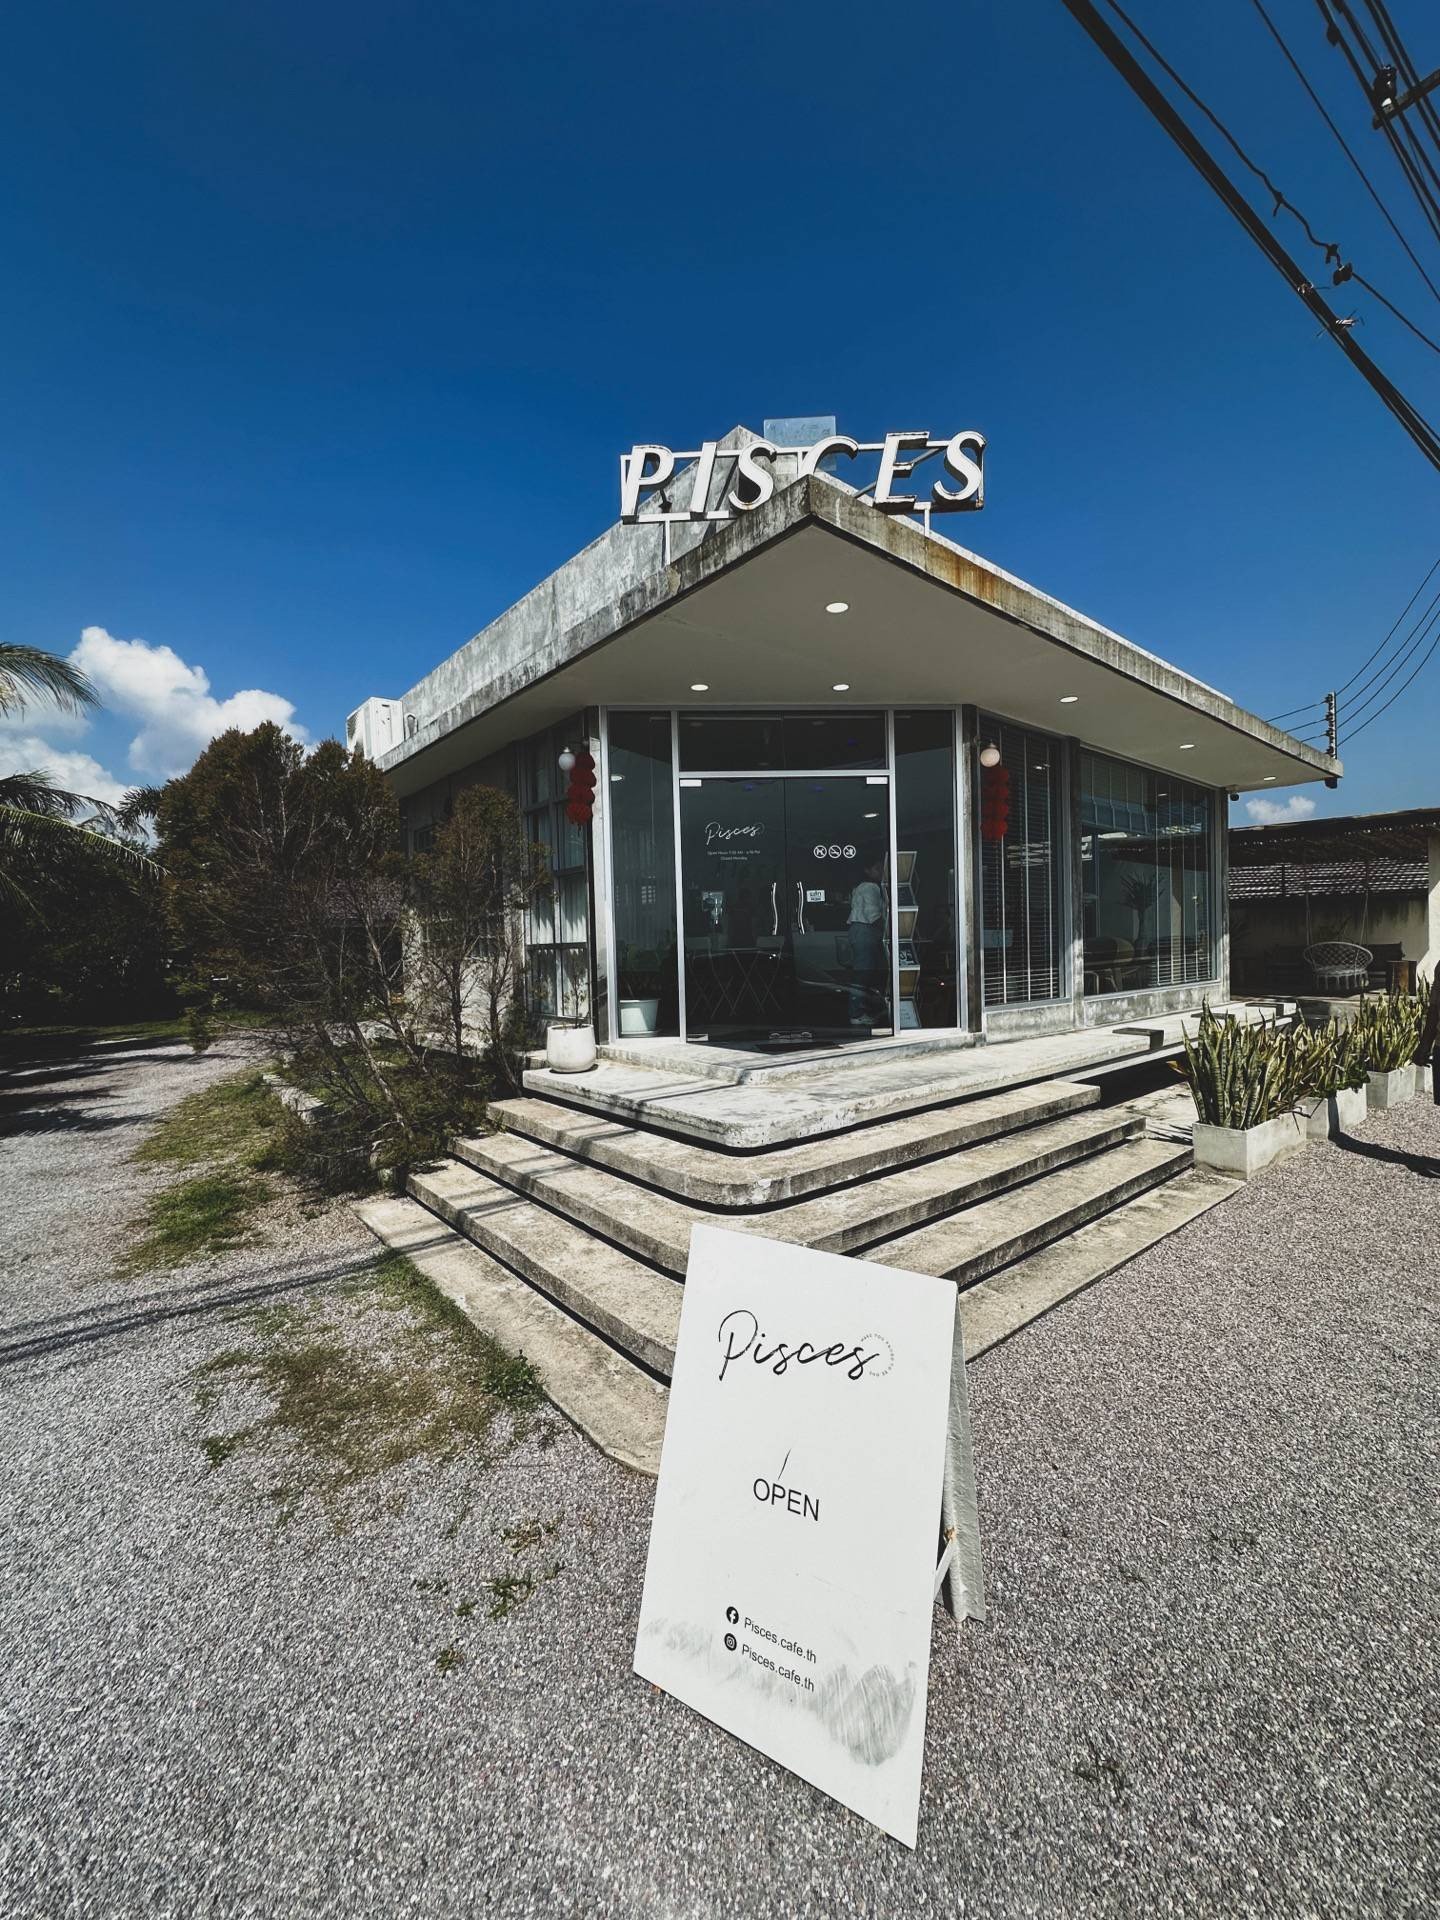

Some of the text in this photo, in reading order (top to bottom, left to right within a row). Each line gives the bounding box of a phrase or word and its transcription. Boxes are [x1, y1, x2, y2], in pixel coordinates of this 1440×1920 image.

[621, 431, 987, 524] PISCES
[704, 821, 761, 846] Pisces
[718, 1309, 880, 1381] Pisces
[753, 1478, 820, 1522] OPEN
[744, 1616, 817, 1664] Pisces.cafe.th
[741, 1643, 815, 1692] Pisces.cafe.th
